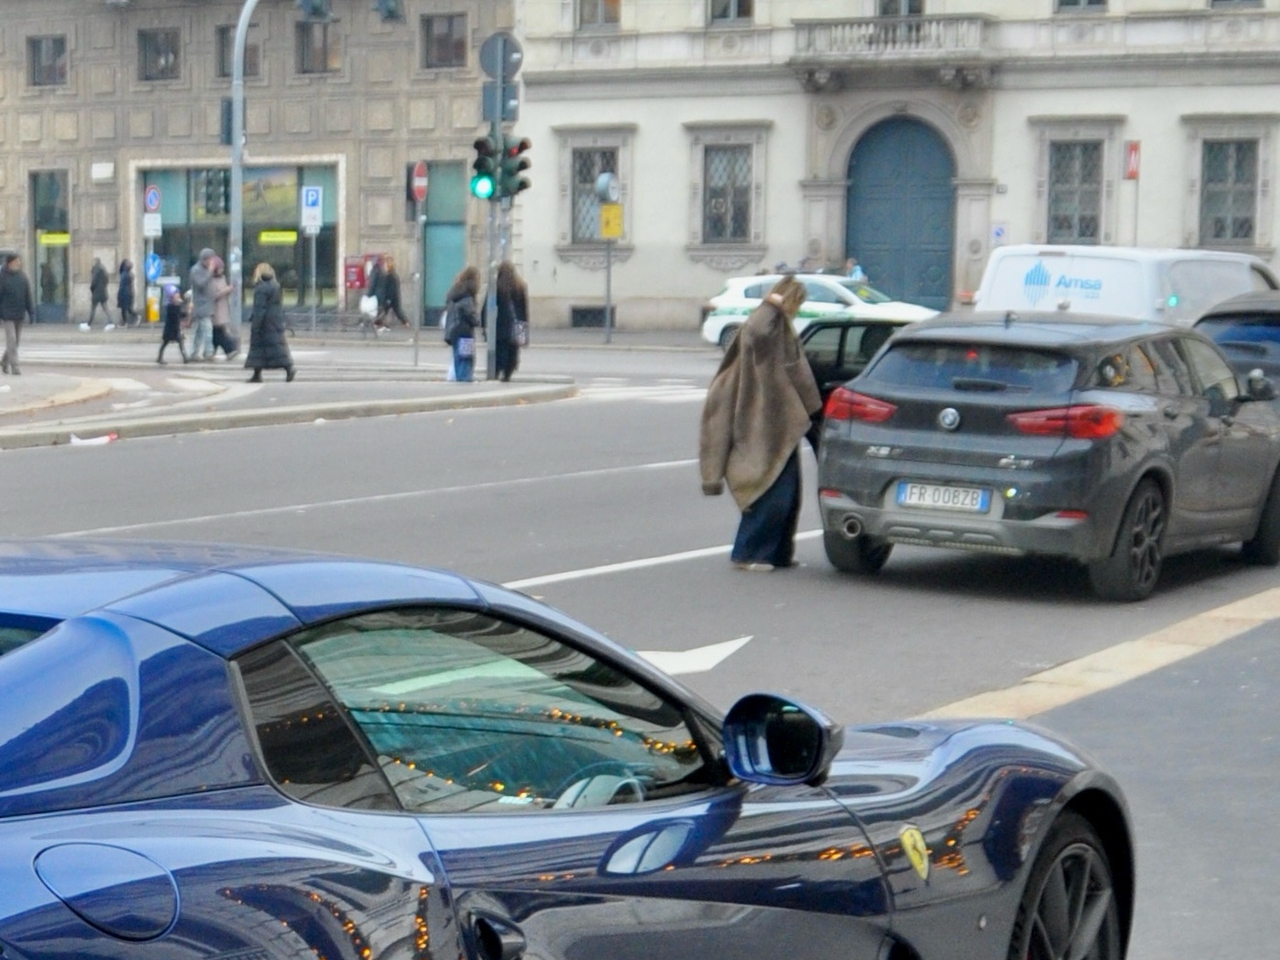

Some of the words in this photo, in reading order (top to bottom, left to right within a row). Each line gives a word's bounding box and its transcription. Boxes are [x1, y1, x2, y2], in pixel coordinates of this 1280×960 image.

[1056, 275, 1102, 290] Amsa
[908, 485, 927, 500] FR
[932, 487, 980, 507] 008ZB
